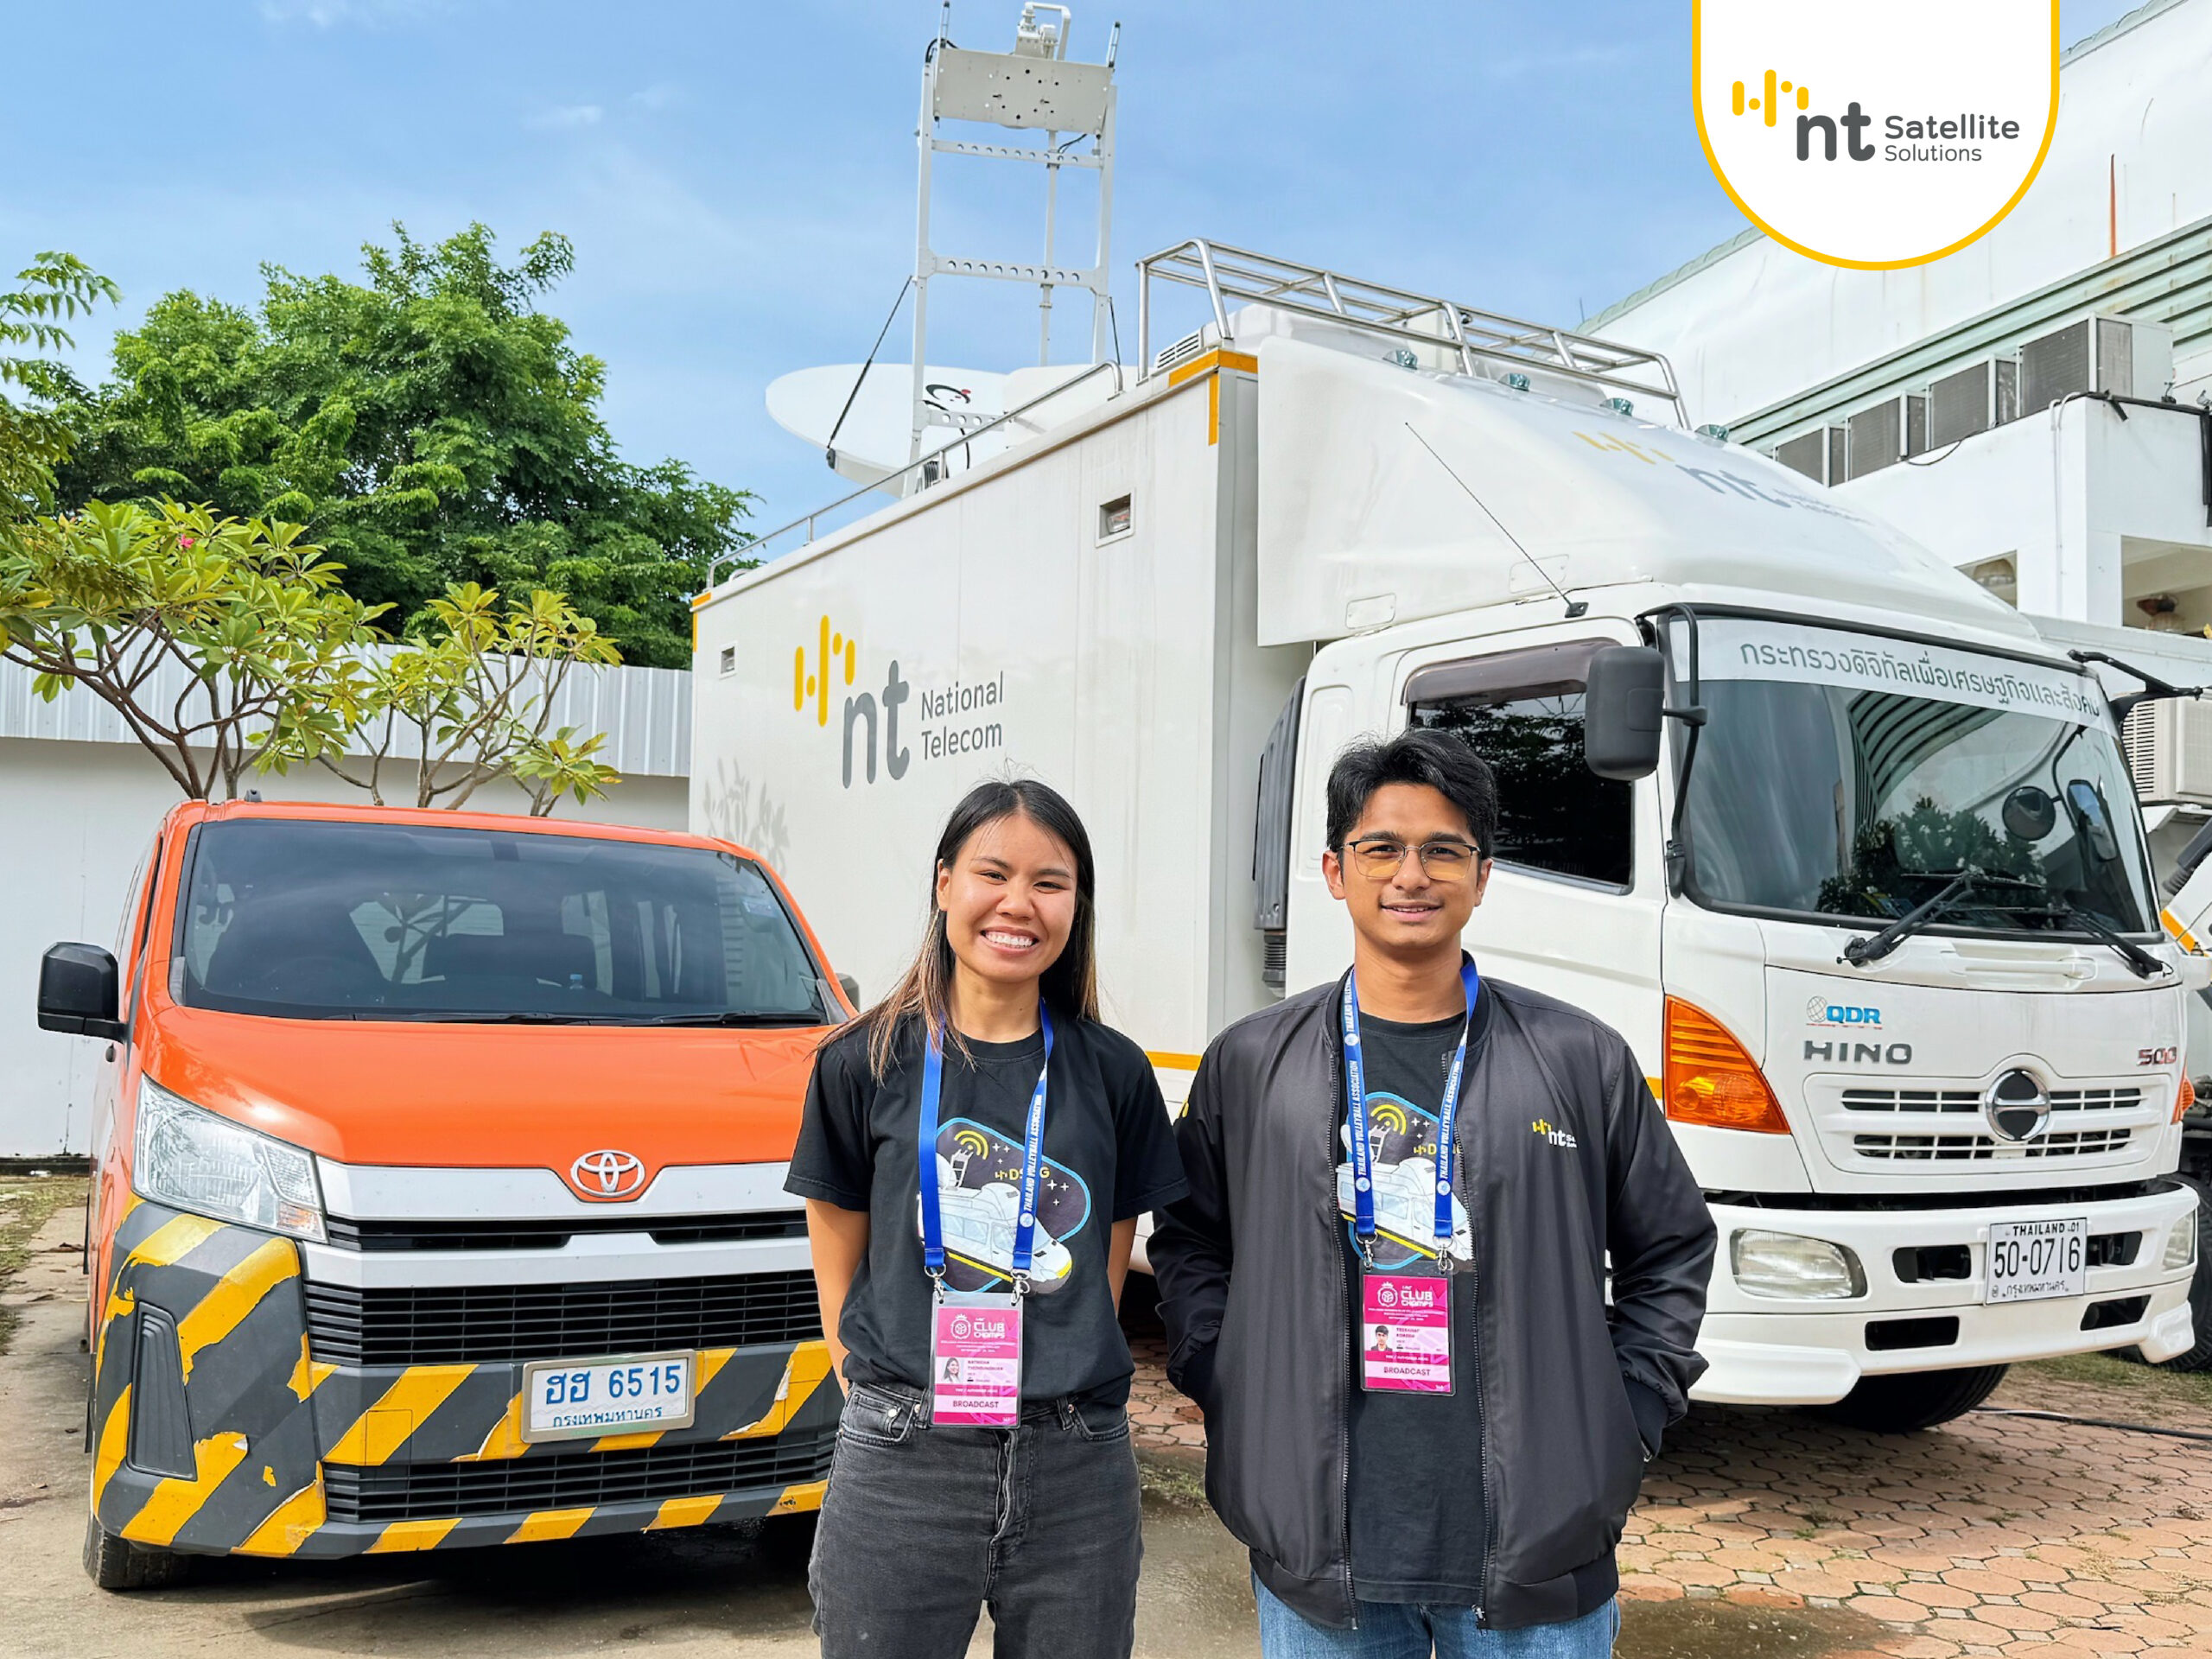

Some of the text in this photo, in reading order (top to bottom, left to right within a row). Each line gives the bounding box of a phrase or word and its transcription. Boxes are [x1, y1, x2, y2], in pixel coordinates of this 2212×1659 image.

[921, 671, 1003, 721] National
[842, 659, 911, 790] nt
[921, 722, 1002, 761] Telecom
[1826, 1005, 1882, 1024] QDR
[1803, 1039, 1913, 1065] HINO
[2138, 1046, 2177, 1066] 500
[1351, 1060, 1367, 1176] THAILAND VOLLEYBALL ASSOCIATION
[1440, 1061, 1460, 1179] THAILAND VOLLEYBALL ASSOCIATION
[1024, 1094, 1042, 1211] THAILAND VOLLEYBALL ASSOCIATION
[2012, 1223, 2065, 1236] THAILAND
[1994, 1236, 2082, 1279] 50-0716
[1401, 1289, 1433, 1300] CLUB
[973, 1321, 1005, 1332] CLUB
[608, 1364, 682, 1399] 6515
[1383, 1366, 1431, 1376] BROADCAST
[952, 1400, 1000, 1408] BROADCAST
